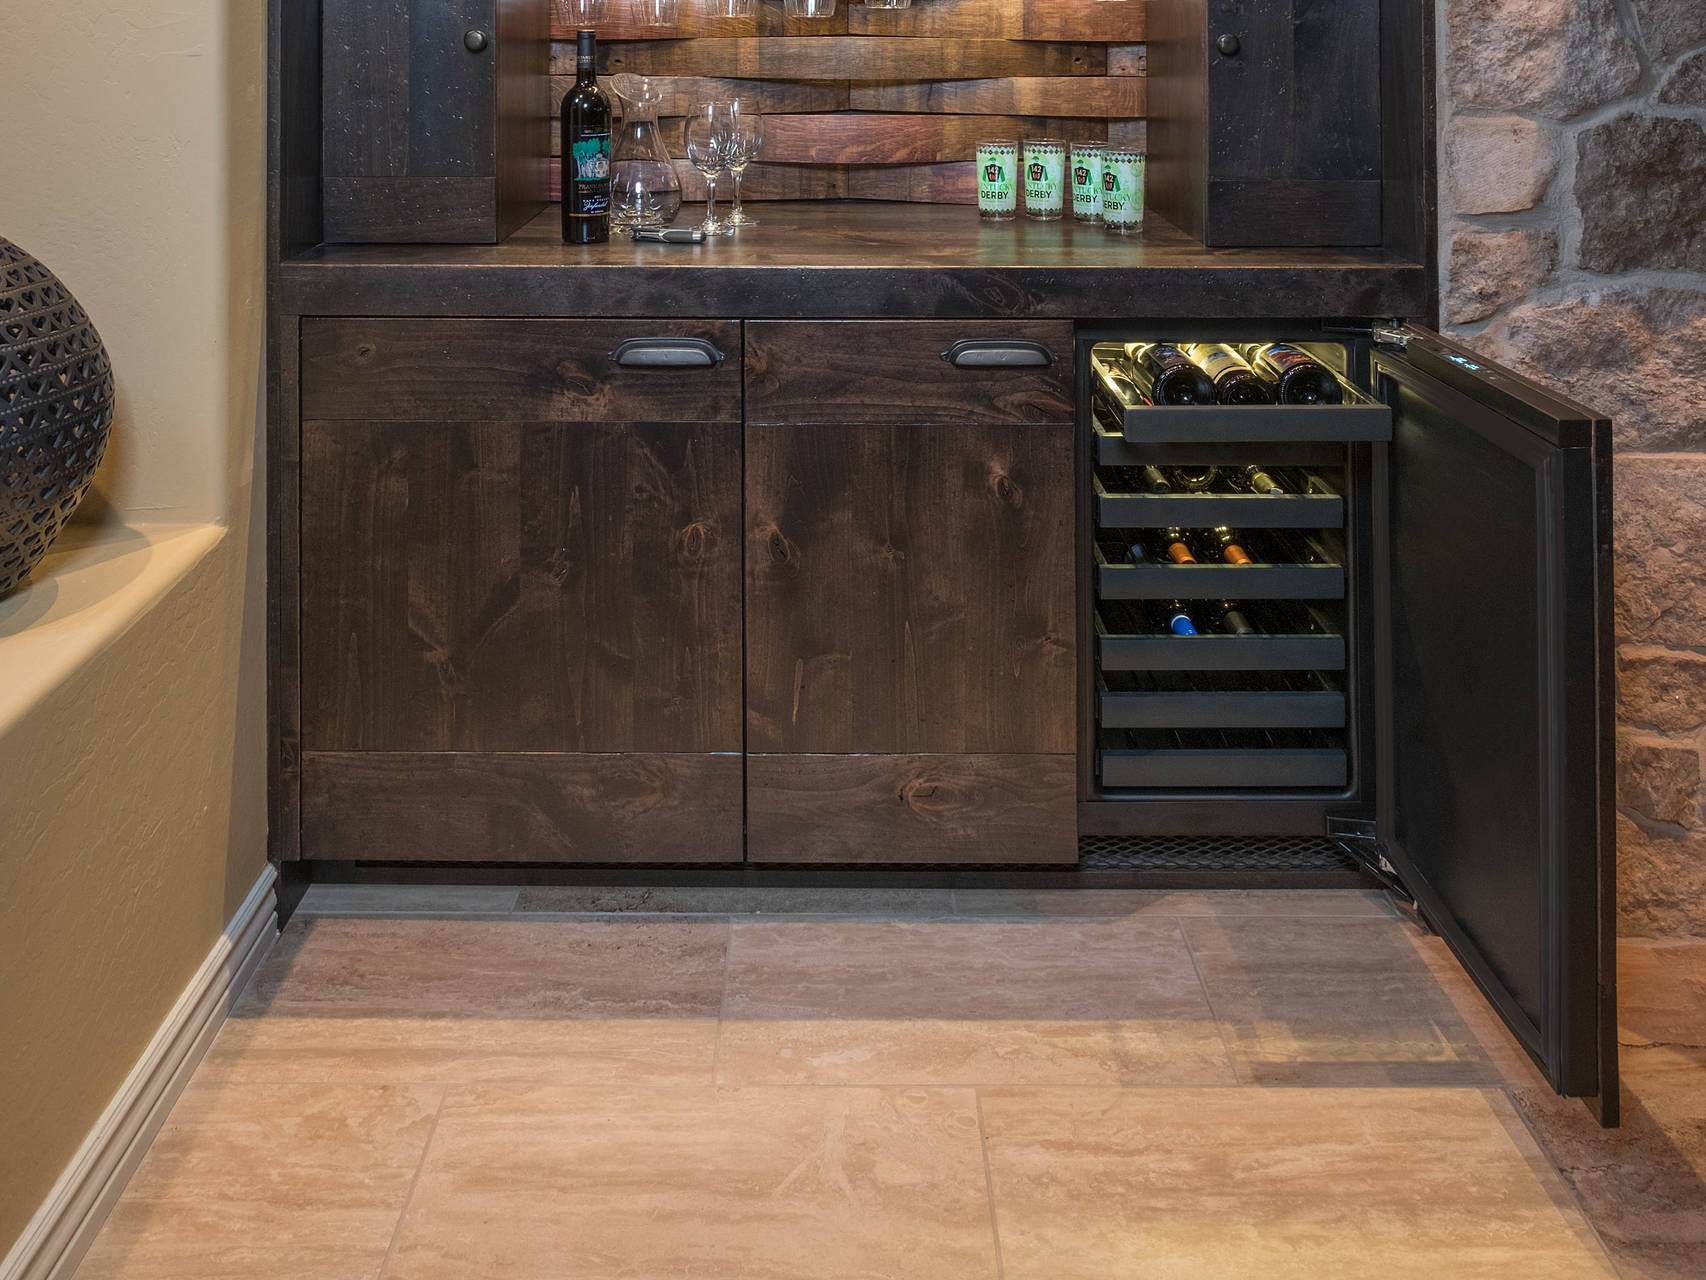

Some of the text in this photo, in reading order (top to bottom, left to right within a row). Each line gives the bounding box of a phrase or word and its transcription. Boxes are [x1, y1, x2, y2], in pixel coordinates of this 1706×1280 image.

[987, 166, 999, 174] 142
[1031, 165, 1042, 173] 142
[1076, 168, 1087, 177] 142
[1104, 174, 1114, 183] 142
[981, 190, 1009, 199] DERBY
[1025, 189, 1052, 199] DERBY
[1103, 199, 1125, 210] ERBY
